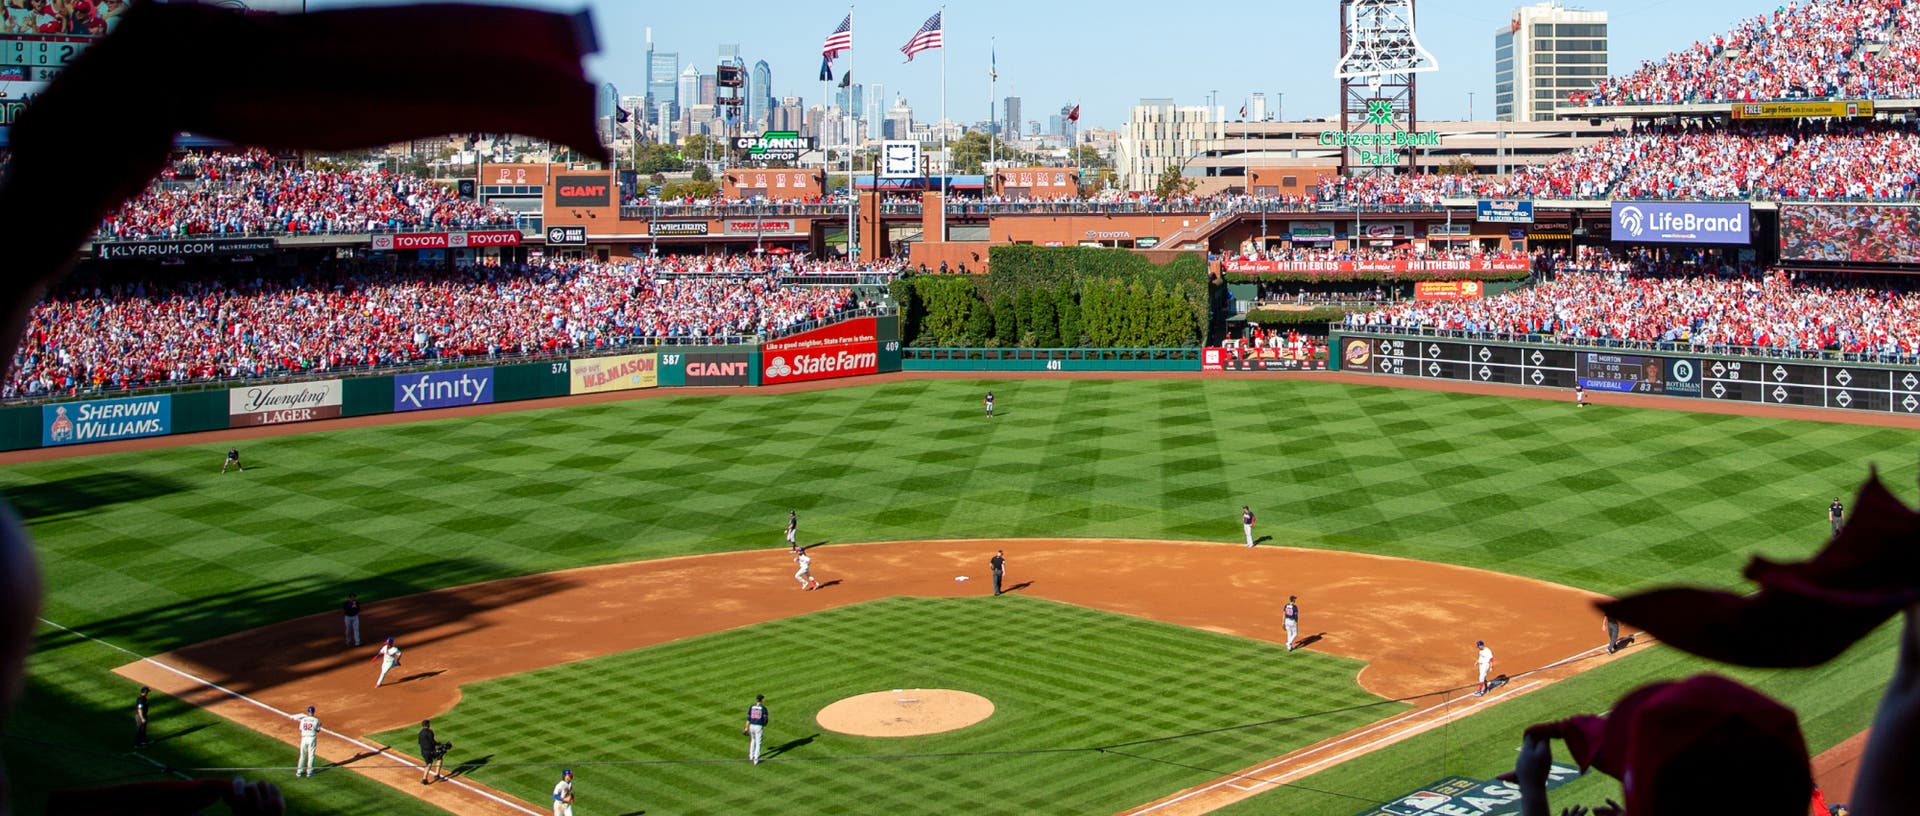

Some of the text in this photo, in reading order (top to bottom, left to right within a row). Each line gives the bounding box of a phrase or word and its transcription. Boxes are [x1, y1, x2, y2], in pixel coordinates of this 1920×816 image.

[16, 54, 23, 64] 4
[60, 45, 74, 63] 2
[1744, 104, 1761, 114] FREE
[1320, 129, 1440, 146] Citizens Bank
[758, 138, 808, 149] RANKIN
[1361, 149, 1399, 165] Park
[500, 168, 510, 180] P
[559, 186, 606, 197] GIANT
[1650, 212, 1742, 232] LifeBrand
[396, 236, 445, 247] TOYOTA
[470, 233, 516, 244] TOYOTA
[111, 243, 214, 256] KLYRRUM.COM
[1408, 260, 1470, 271] #HITTHEBUDS
[784, 342, 798, 350] good
[799, 340, 823, 348] neighbor,
[885, 342, 899, 351] 409
[1392, 340, 1404, 348] HOU
[663, 354, 680, 365] 387
[1046, 360, 1062, 370] 401
[552, 363, 568, 374] 374
[686, 362, 748, 376] GIANT
[1680, 367, 1687, 376] R
[1728, 362, 1740, 370] LAD
[401, 374, 488, 407] xfinity
[1586, 380, 1622, 390] CURVEBALL
[1640, 384, 1651, 392] 83
[245, 385, 330, 411] Yuengling
[78, 401, 160, 421] SHERWIN
[263, 408, 311, 424] LAGER
